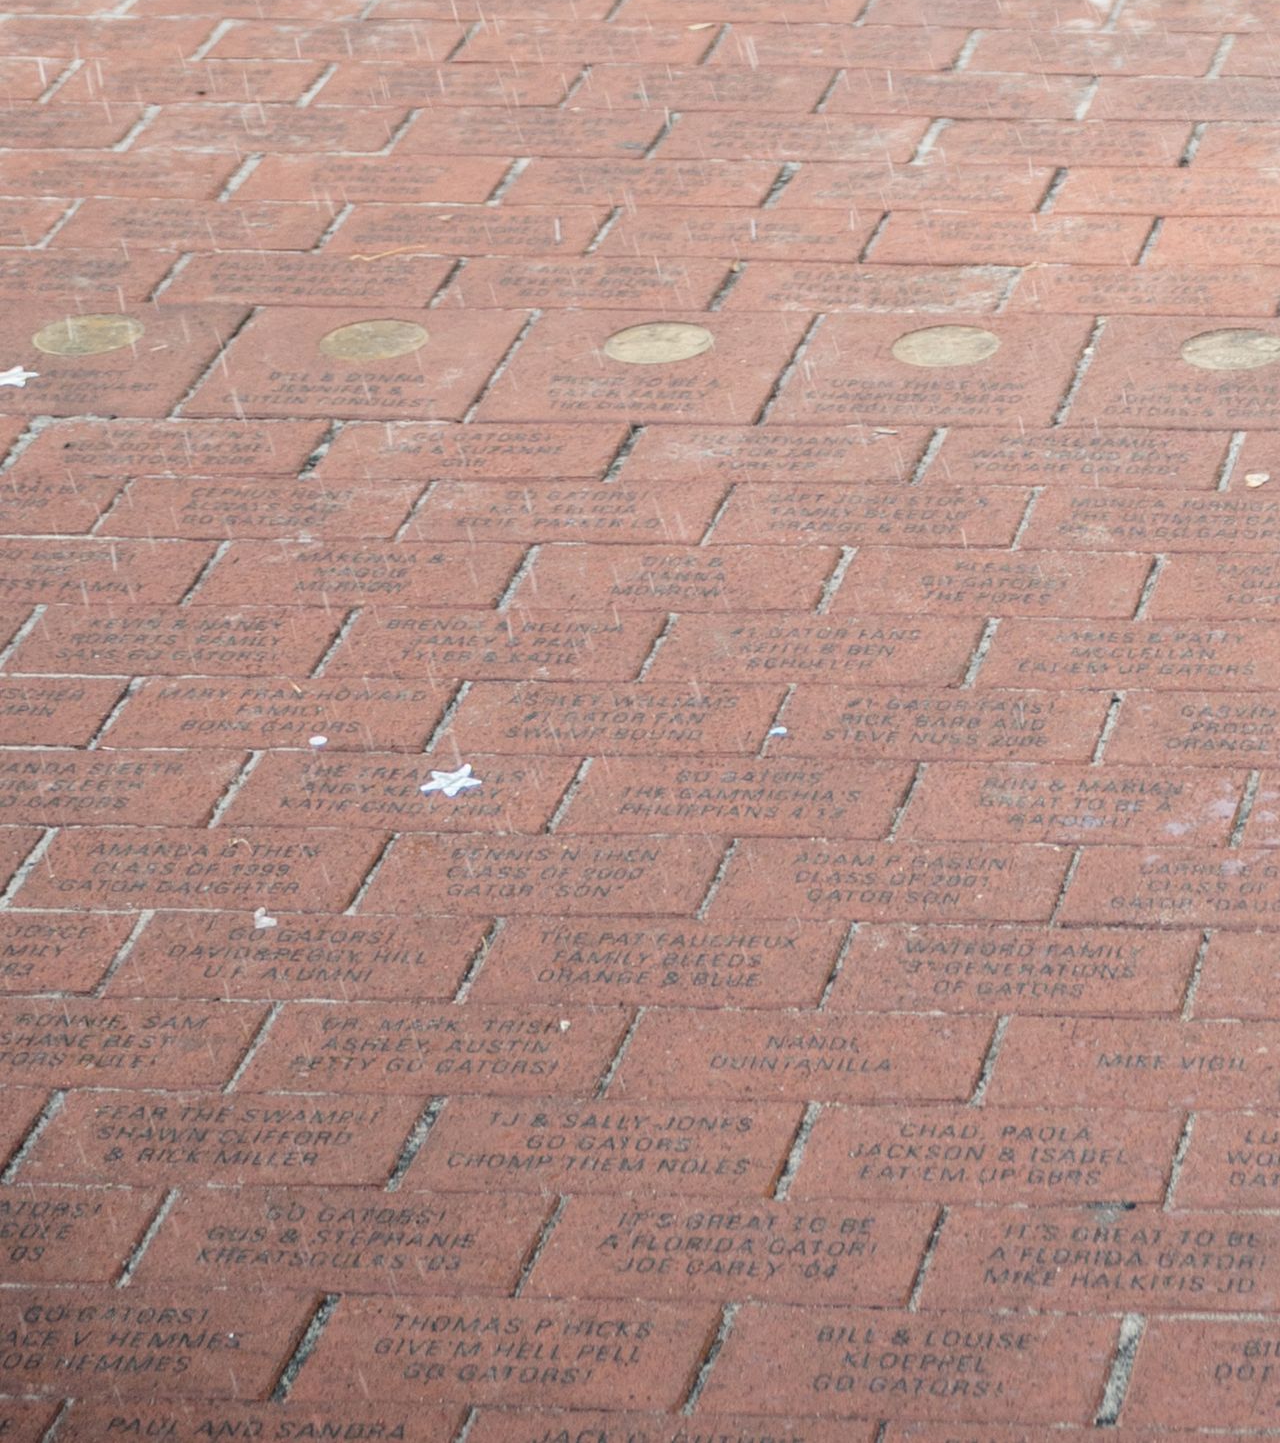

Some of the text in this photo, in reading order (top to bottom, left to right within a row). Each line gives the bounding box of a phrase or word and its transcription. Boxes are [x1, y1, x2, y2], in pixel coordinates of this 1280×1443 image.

[91, 862, 175, 874] CLASS
[185, 863, 219, 875] OF
[57, 880, 300, 894] GATOR DAUGHTER
[96, 1127, 353, 1145] SHAWN CLIFFORD
[103, 1147, 319, 1165] & RICK MILLER
[847, 1145, 1128, 1164] JACKSON & ISABEL
[394, 1316, 655, 1337] THOMAS P HICKS
[816, 1327, 1038, 1349] BILL & LOUISE
[373, 1340, 640, 1364] GIVE'M HELL PELL
[402, 1363, 446, 1379] GO
[106, 1419, 182, 1436] PAUL
[194, 1421, 264, 1438] AND
